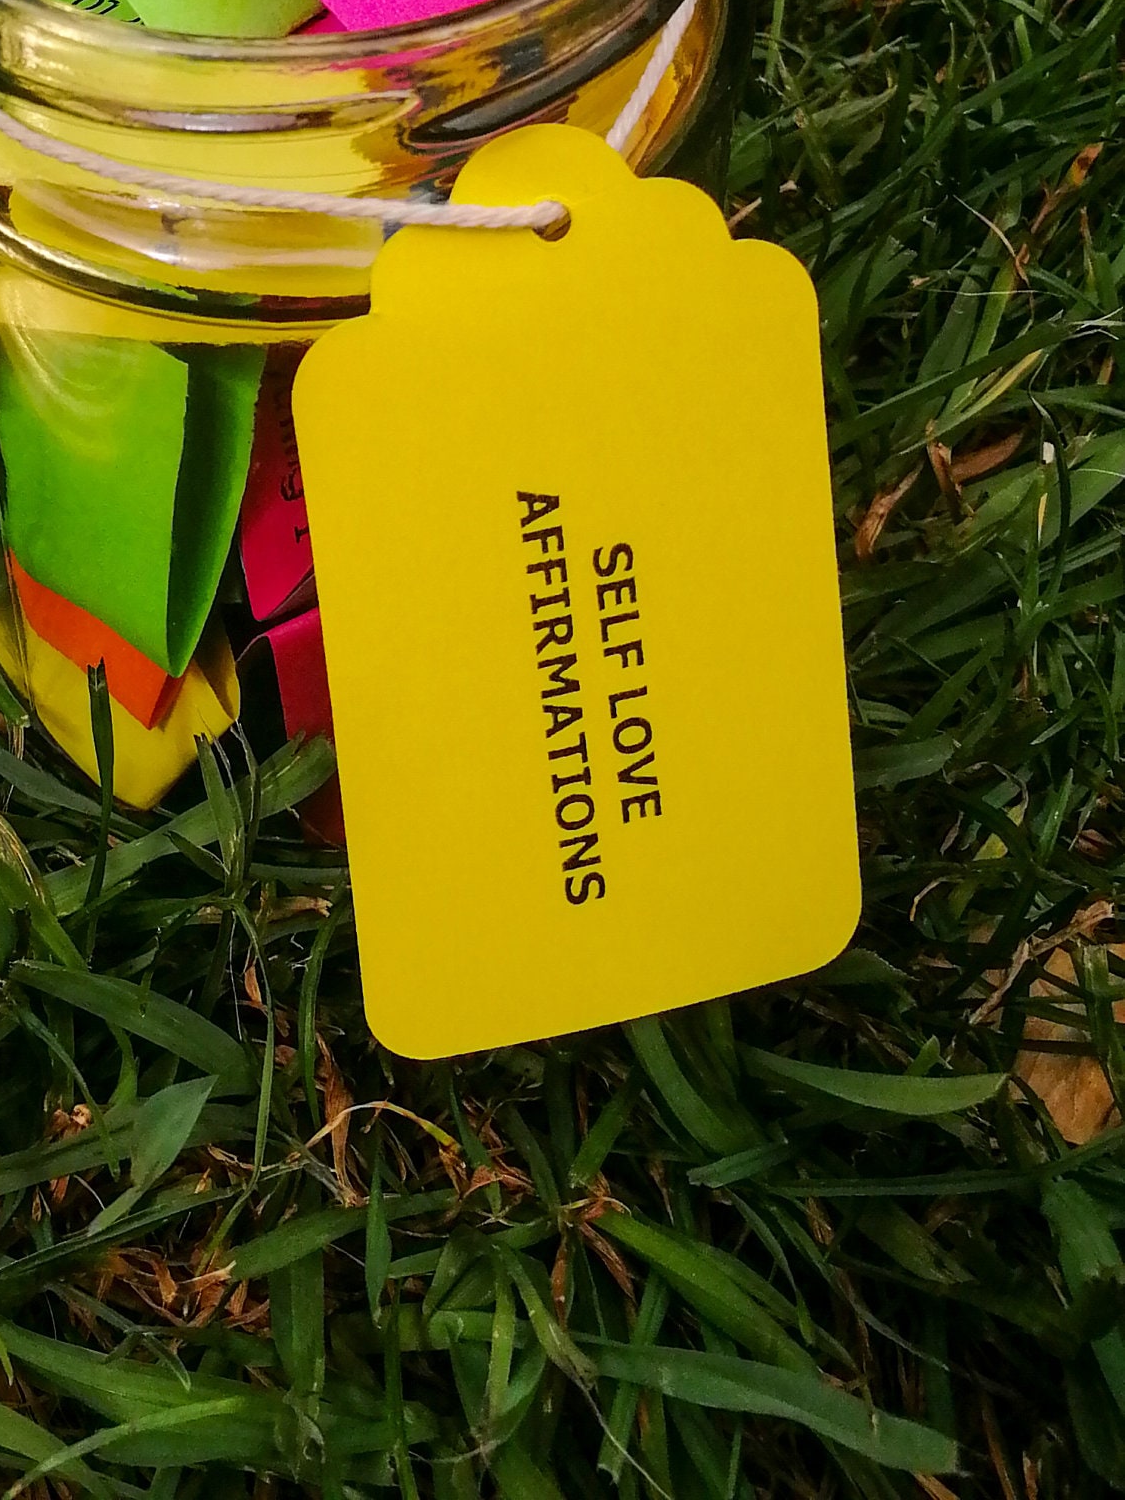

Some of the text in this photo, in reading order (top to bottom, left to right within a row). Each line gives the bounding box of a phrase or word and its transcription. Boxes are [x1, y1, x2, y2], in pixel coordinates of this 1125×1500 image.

[516, 490, 606, 906] AFFIRMATIONS
[592, 543, 663, 824] SELF LOVE
